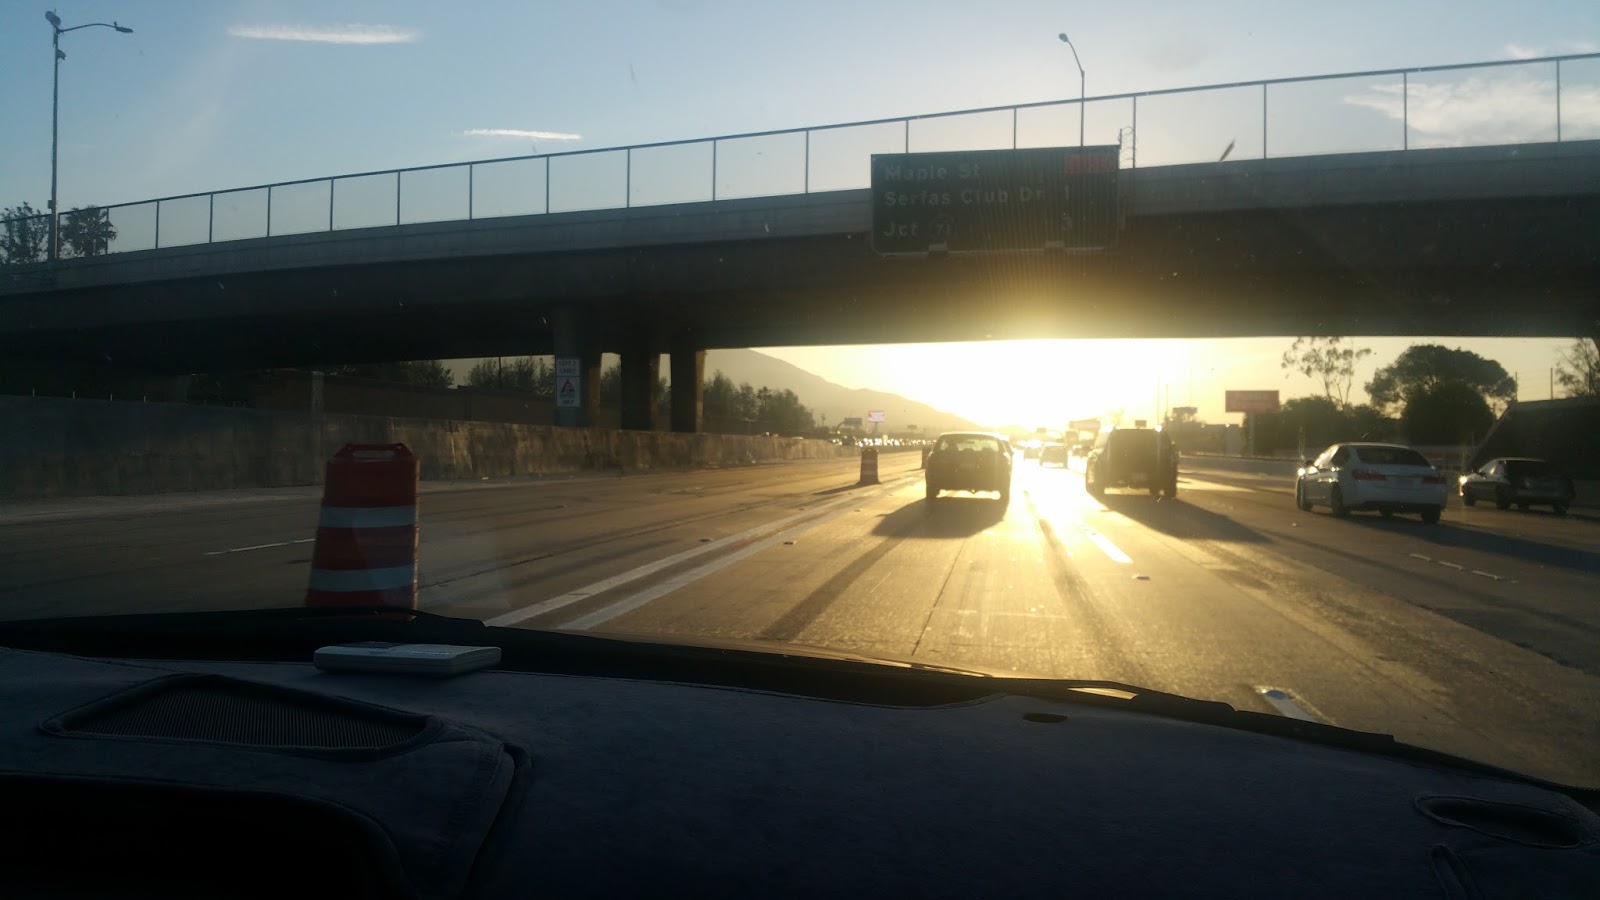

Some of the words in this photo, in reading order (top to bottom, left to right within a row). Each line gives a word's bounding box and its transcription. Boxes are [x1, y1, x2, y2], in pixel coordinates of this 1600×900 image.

[884, 163, 948, 183] Maple
[960, 162, 982, 178] St
[884, 189, 953, 207] Serfas
[961, 186, 1009, 204] Club
[1020, 186, 1043, 202] Dr
[883, 220, 919, 237] Jct
